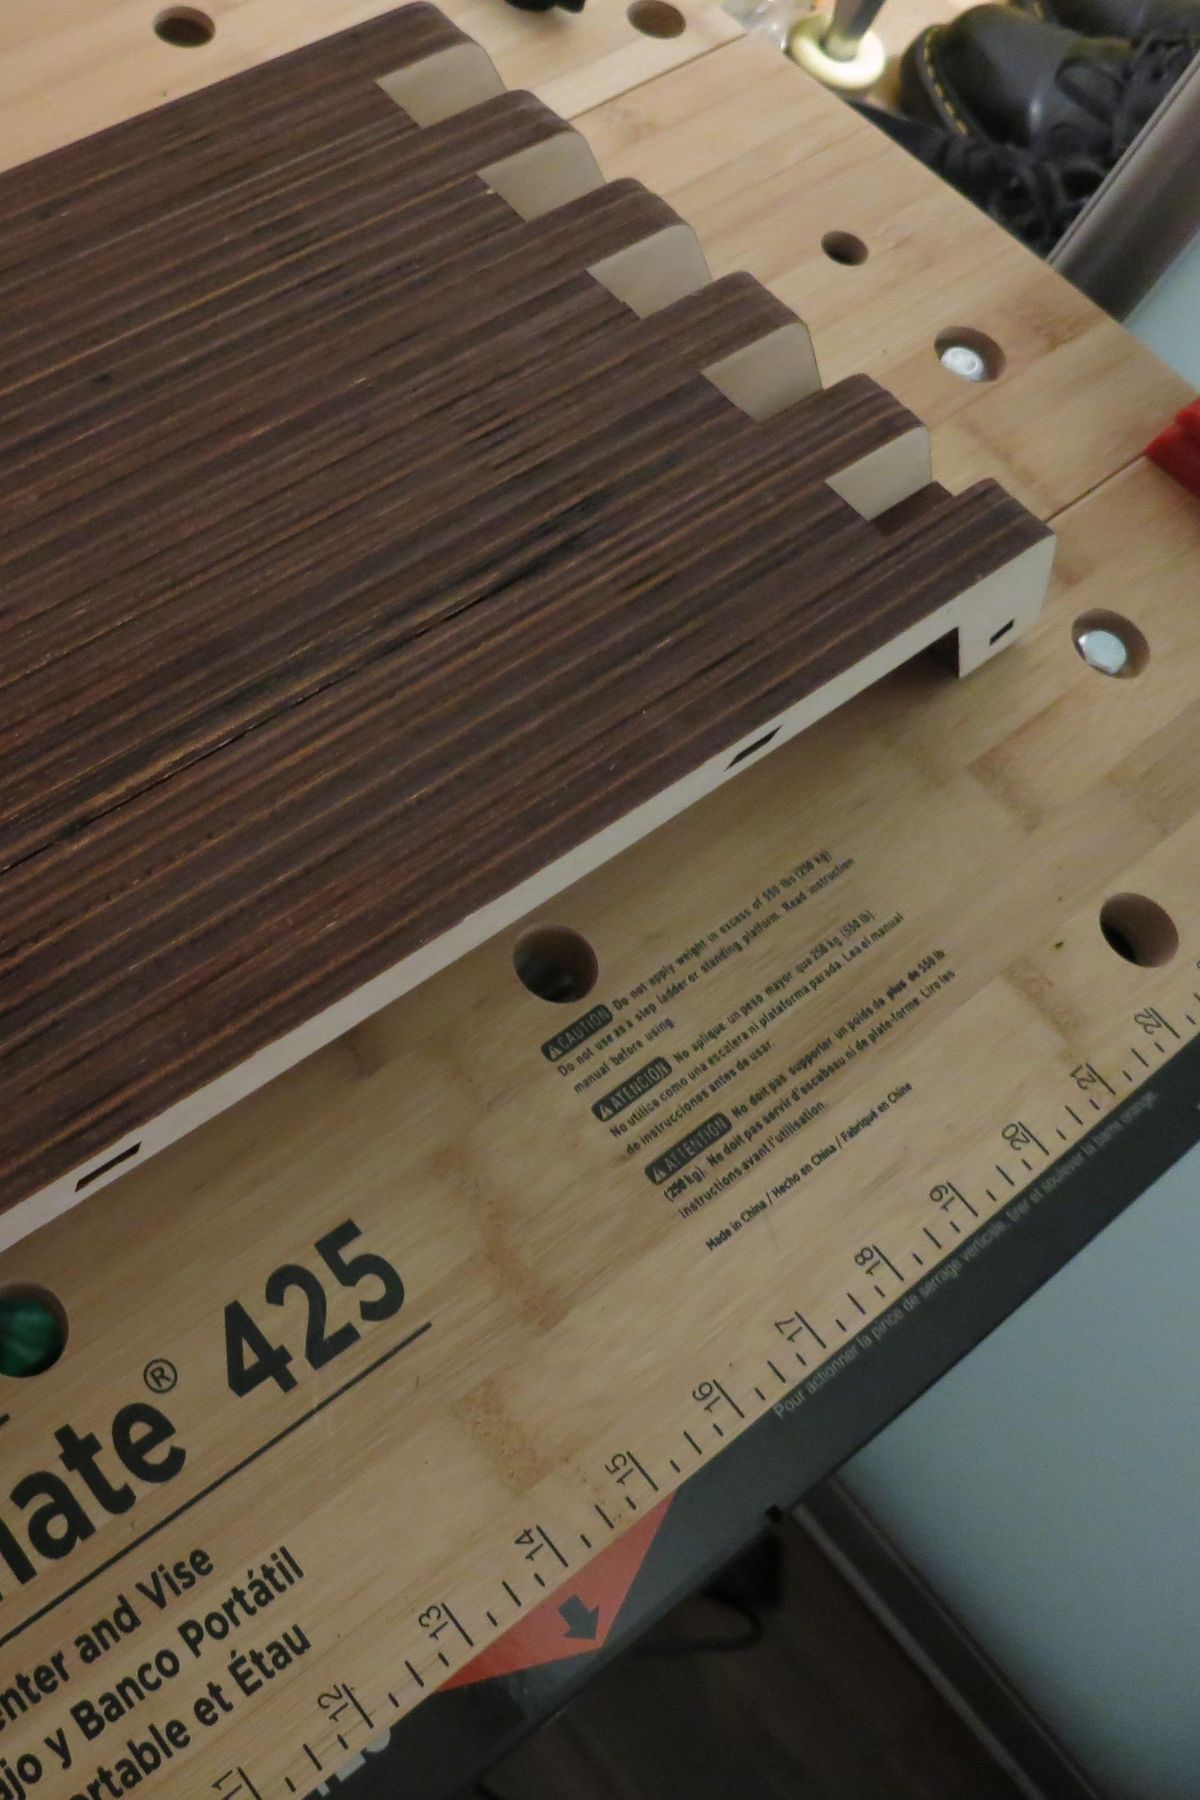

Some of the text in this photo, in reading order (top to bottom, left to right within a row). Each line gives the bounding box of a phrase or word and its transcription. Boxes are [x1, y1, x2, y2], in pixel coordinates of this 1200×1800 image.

[558, 1008, 609, 1048] CAUTION
[614, 996, 628, 1009] Do
[630, 983, 646, 997] not
[648, 963, 675, 986] apply
[675, 940, 708, 967] weight
[721, 910, 750, 933] excess
[753, 899, 762, 909] of
[558, 1061, 574, 1076] Do
[575, 1047, 593, 1063] not
[596, 1035, 613, 1049] use
[614, 1026, 625, 1036] as
[634, 1002, 657, 1022] step
[657, 978, 688, 1003] ladder
[688, 973, 698, 982] or
[700, 940, 742, 974] standing
[783, 892, 806, 912] Read
[673, 1047, 689, 1062] No
[689, 1021, 726, 1052] aplique
[727, 1011, 740, 1023] un
[741, 995, 765, 1015] peso
[765, 972, 794, 997] mayor
[796, 958, 814, 974] que
[610, 1120, 626, 1136] No
[625, 1096, 659, 1124] utilice
[660, 1078, 687, 1100] como
[688, 1063, 707, 1079] una
[706, 1029, 748, 1064] escalera
[747, 1021, 759, 1033] ni
[758, 984, 811, 1027] plataforma
[842, 945, 861, 962] Lea
[860, 937, 871, 949] el
[869, 913, 904, 941] manual
[1133, 1006, 1162, 1035] 22
[573, 1062, 610, 1092] manual
[610, 1038, 643, 1065] before
[663, 1117, 727, 1170] ATTENTION
[748, 1086, 768, 1104] doit
[769, 1074, 788, 1092] pas
[787, 1037, 834, 1077] supporter
[836, 1027, 848, 1038] un
[846, 1006, 875, 1031] poids
[872, 996, 885, 1009] de
[886, 979, 909, 1001] plus
[706, 1150, 723, 1165] Ne
[721, 1134, 743, 1154] doit
[744, 1122, 764, 1141] pas
[761, 1097, 791, 1123] servir
[844, 1047, 856, 1059] ni
[855, 1037, 868, 1051] de
[1069, 1064, 1098, 1091] 21
[625, 1140, 640, 1154] de
[639, 1088, 708, 1143] instrucciones
[707, 1067, 736, 1092] antes
[735, 1057, 750, 1071] de
[1001, 1123, 1031, 1152] 20
[705, 1226, 731, 1249] Made
[729, 1218, 741, 1230] in
[740, 1198, 766, 1222] China
[771, 1171, 800, 1197] Hecho
[800, 1164, 812, 1175] en
[811, 1143, 836, 1166] China
[841, 1110, 880, 1144] Fabriqué
[878, 1103, 890, 1113] en
[888, 1082, 913, 1104] Chine
[740, 1143, 769, 1169] avant
[929, 1183, 957, 1213] 19
[854, 1246, 881, 1276] 18
[221, 1218, 406, 1399] 425
[773, 1388, 805, 1418] Pour
[806, 1343, 858, 1394] actionner
[857, 1333, 872, 1349] la
[871, 1308, 904, 1341] pince
[902, 1293, 920, 1312] de
[918, 1257, 962, 1297] serrage
[774, 1317, 803, 1343] 17
[691, 1381, 721, 1414] 16
[604, 1452, 634, 1486] 15
[513, 1526, 549, 1562] 14
[73, 1593, 142, 1665] and
[134, 1548, 214, 1610] Vise
[417, 1604, 451, 1641] 13
[43, 1727, 72, 1770] y
[69, 1648, 180, 1741] Banco
[176, 1545, 305, 1658] Portátil
[69, 1623, 312, 1800] rtable et Étau
[317, 1684, 349, 1723] 12
